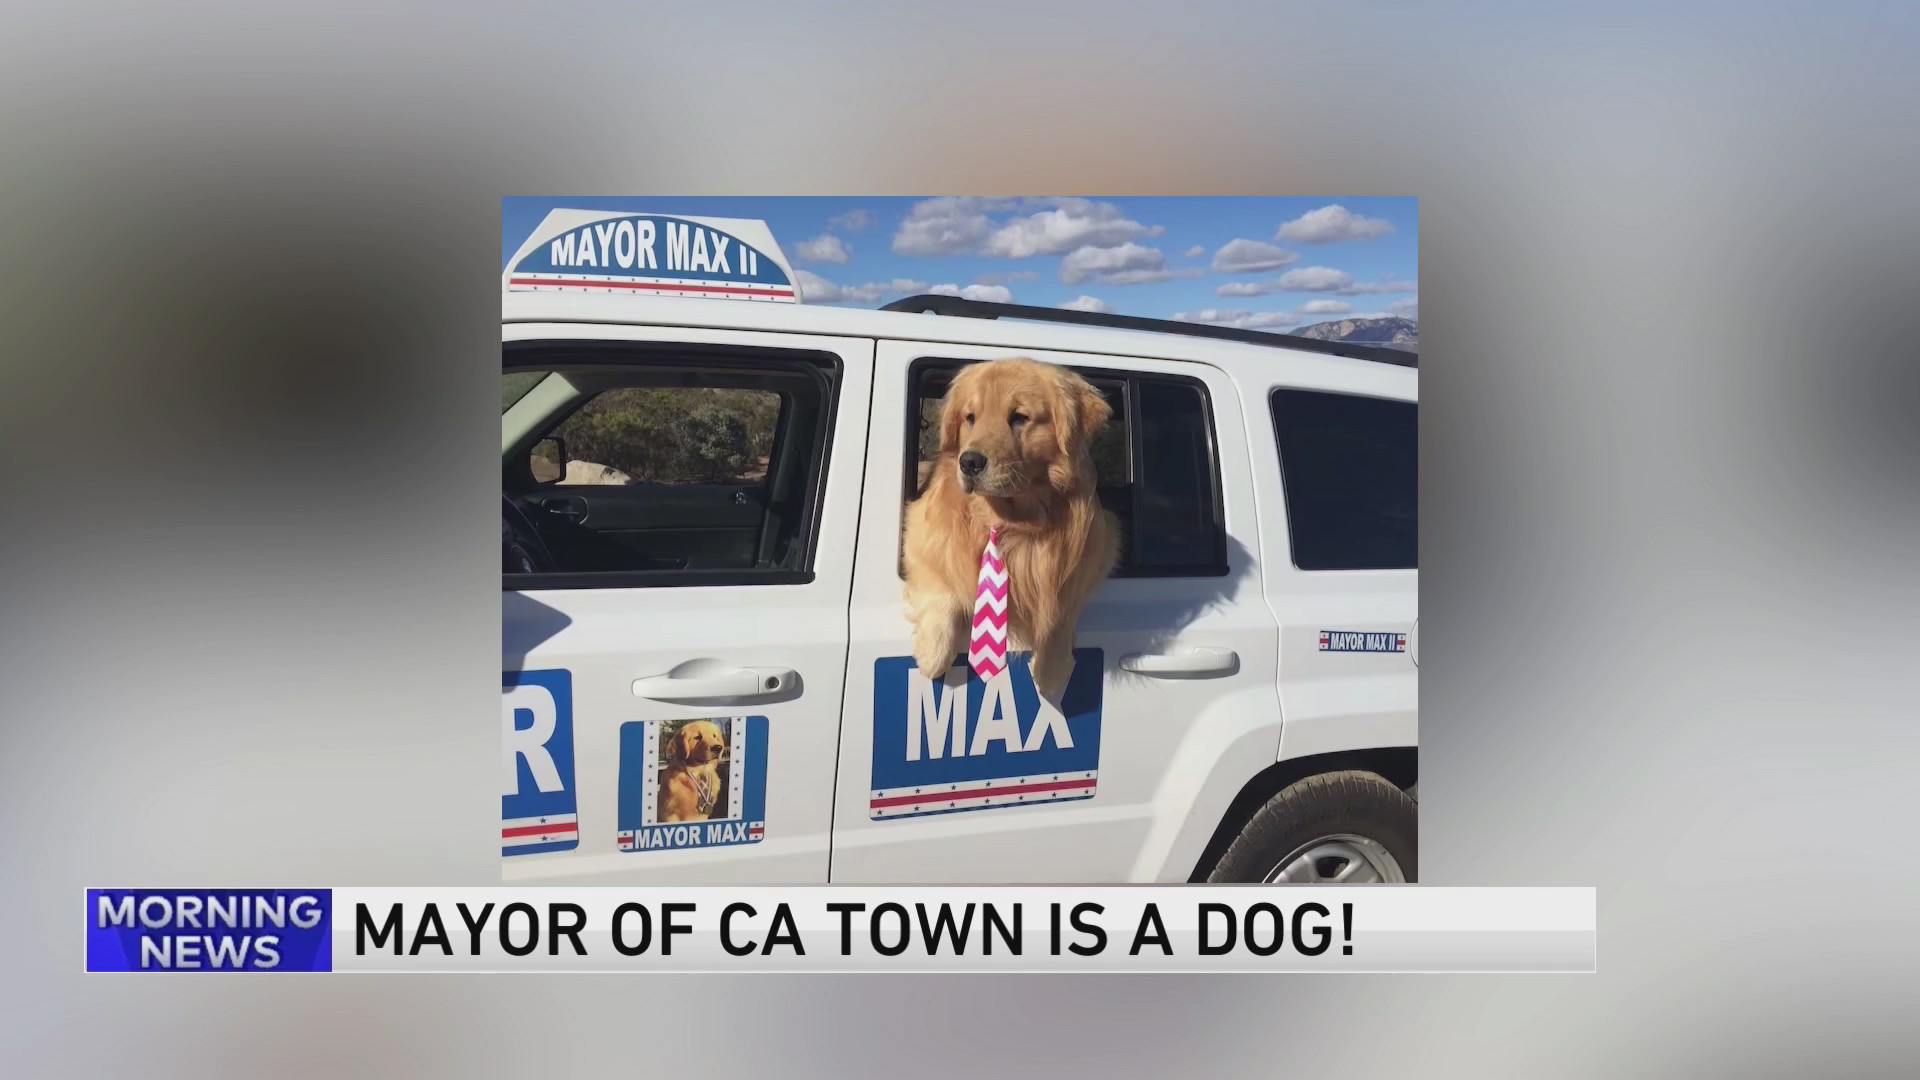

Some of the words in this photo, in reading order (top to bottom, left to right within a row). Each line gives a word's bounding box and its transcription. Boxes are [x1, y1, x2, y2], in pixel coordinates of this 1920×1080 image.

[551, 219, 658, 270] MAYOR
[666, 221, 731, 274] MAX
[1330, 632, 1364, 651] MAYOR
[1365, 633, 1387, 651] MAX
[905, 662, 1075, 762] MAX
[634, 827, 701, 850] MAYOR
[706, 822, 747, 845] MAX
